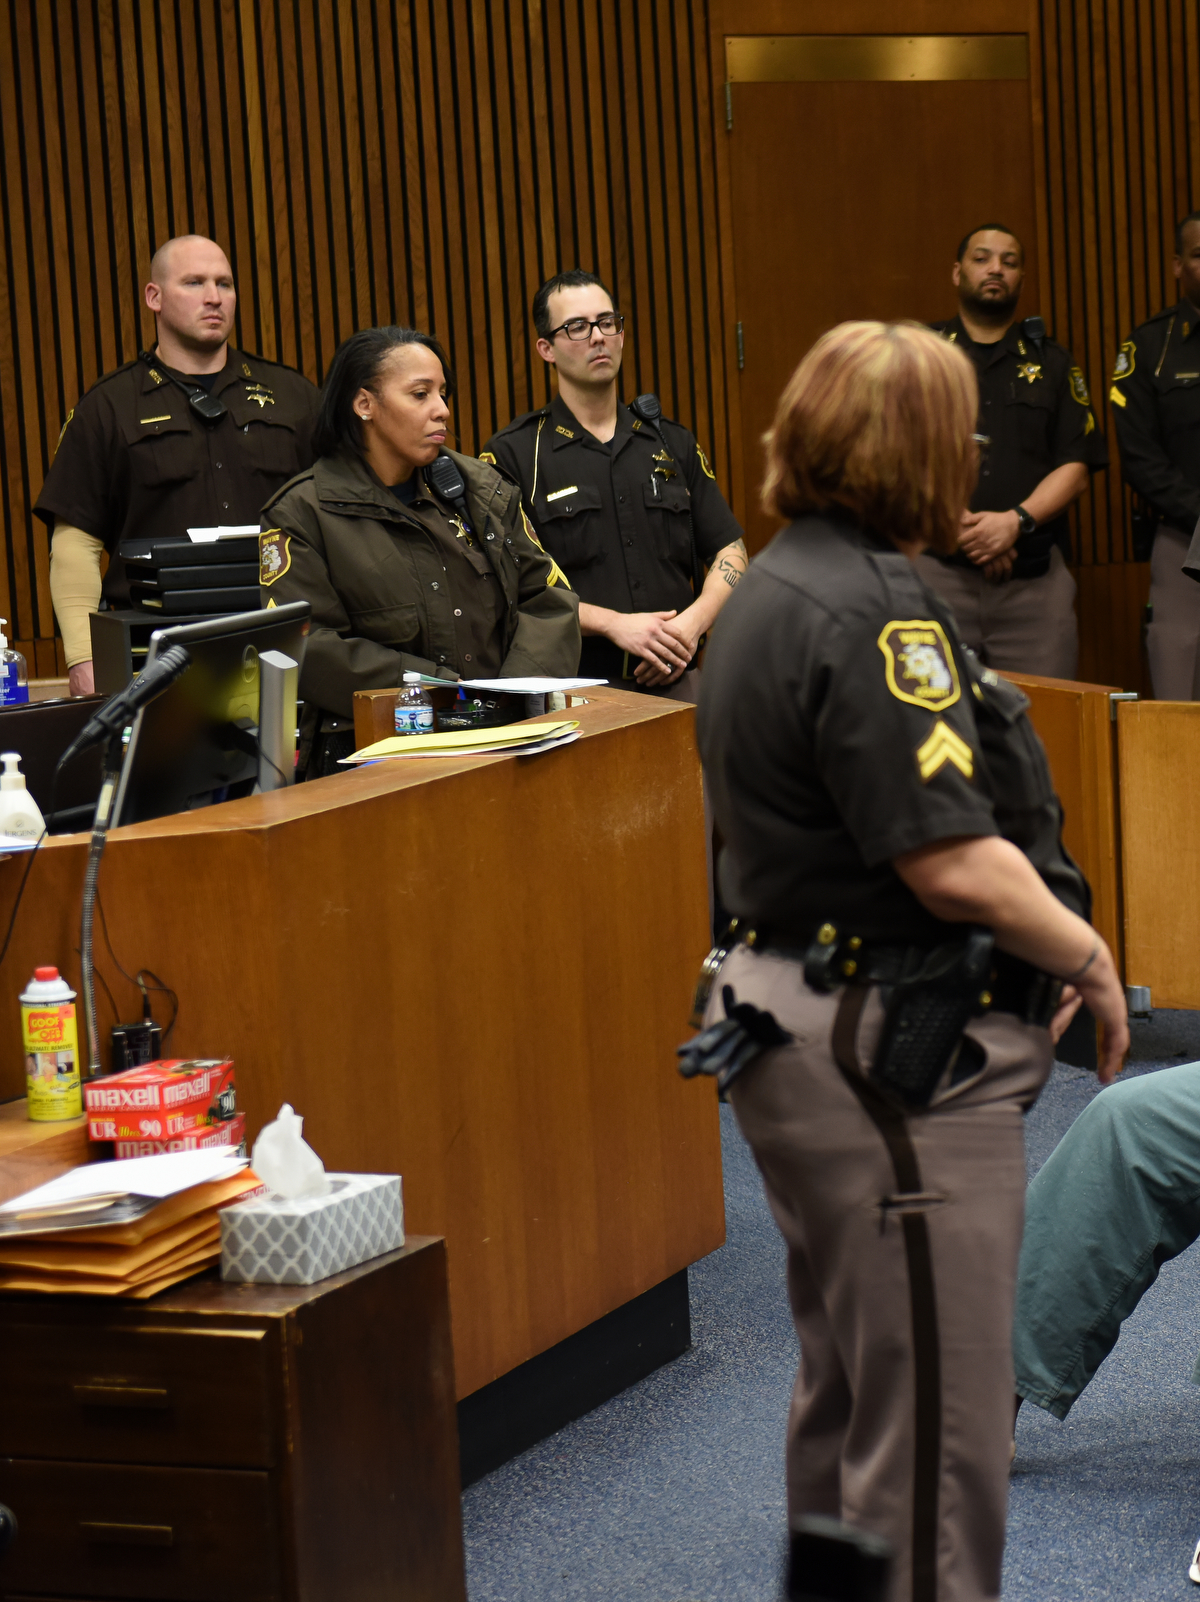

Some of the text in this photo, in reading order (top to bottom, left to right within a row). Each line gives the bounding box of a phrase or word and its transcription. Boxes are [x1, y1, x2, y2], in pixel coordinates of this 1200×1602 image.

[87, 1084, 160, 1106] maxell
[163, 1071, 210, 1105] maxell
[90, 1121, 118, 1138] UR
[139, 1119, 162, 1137] 90
